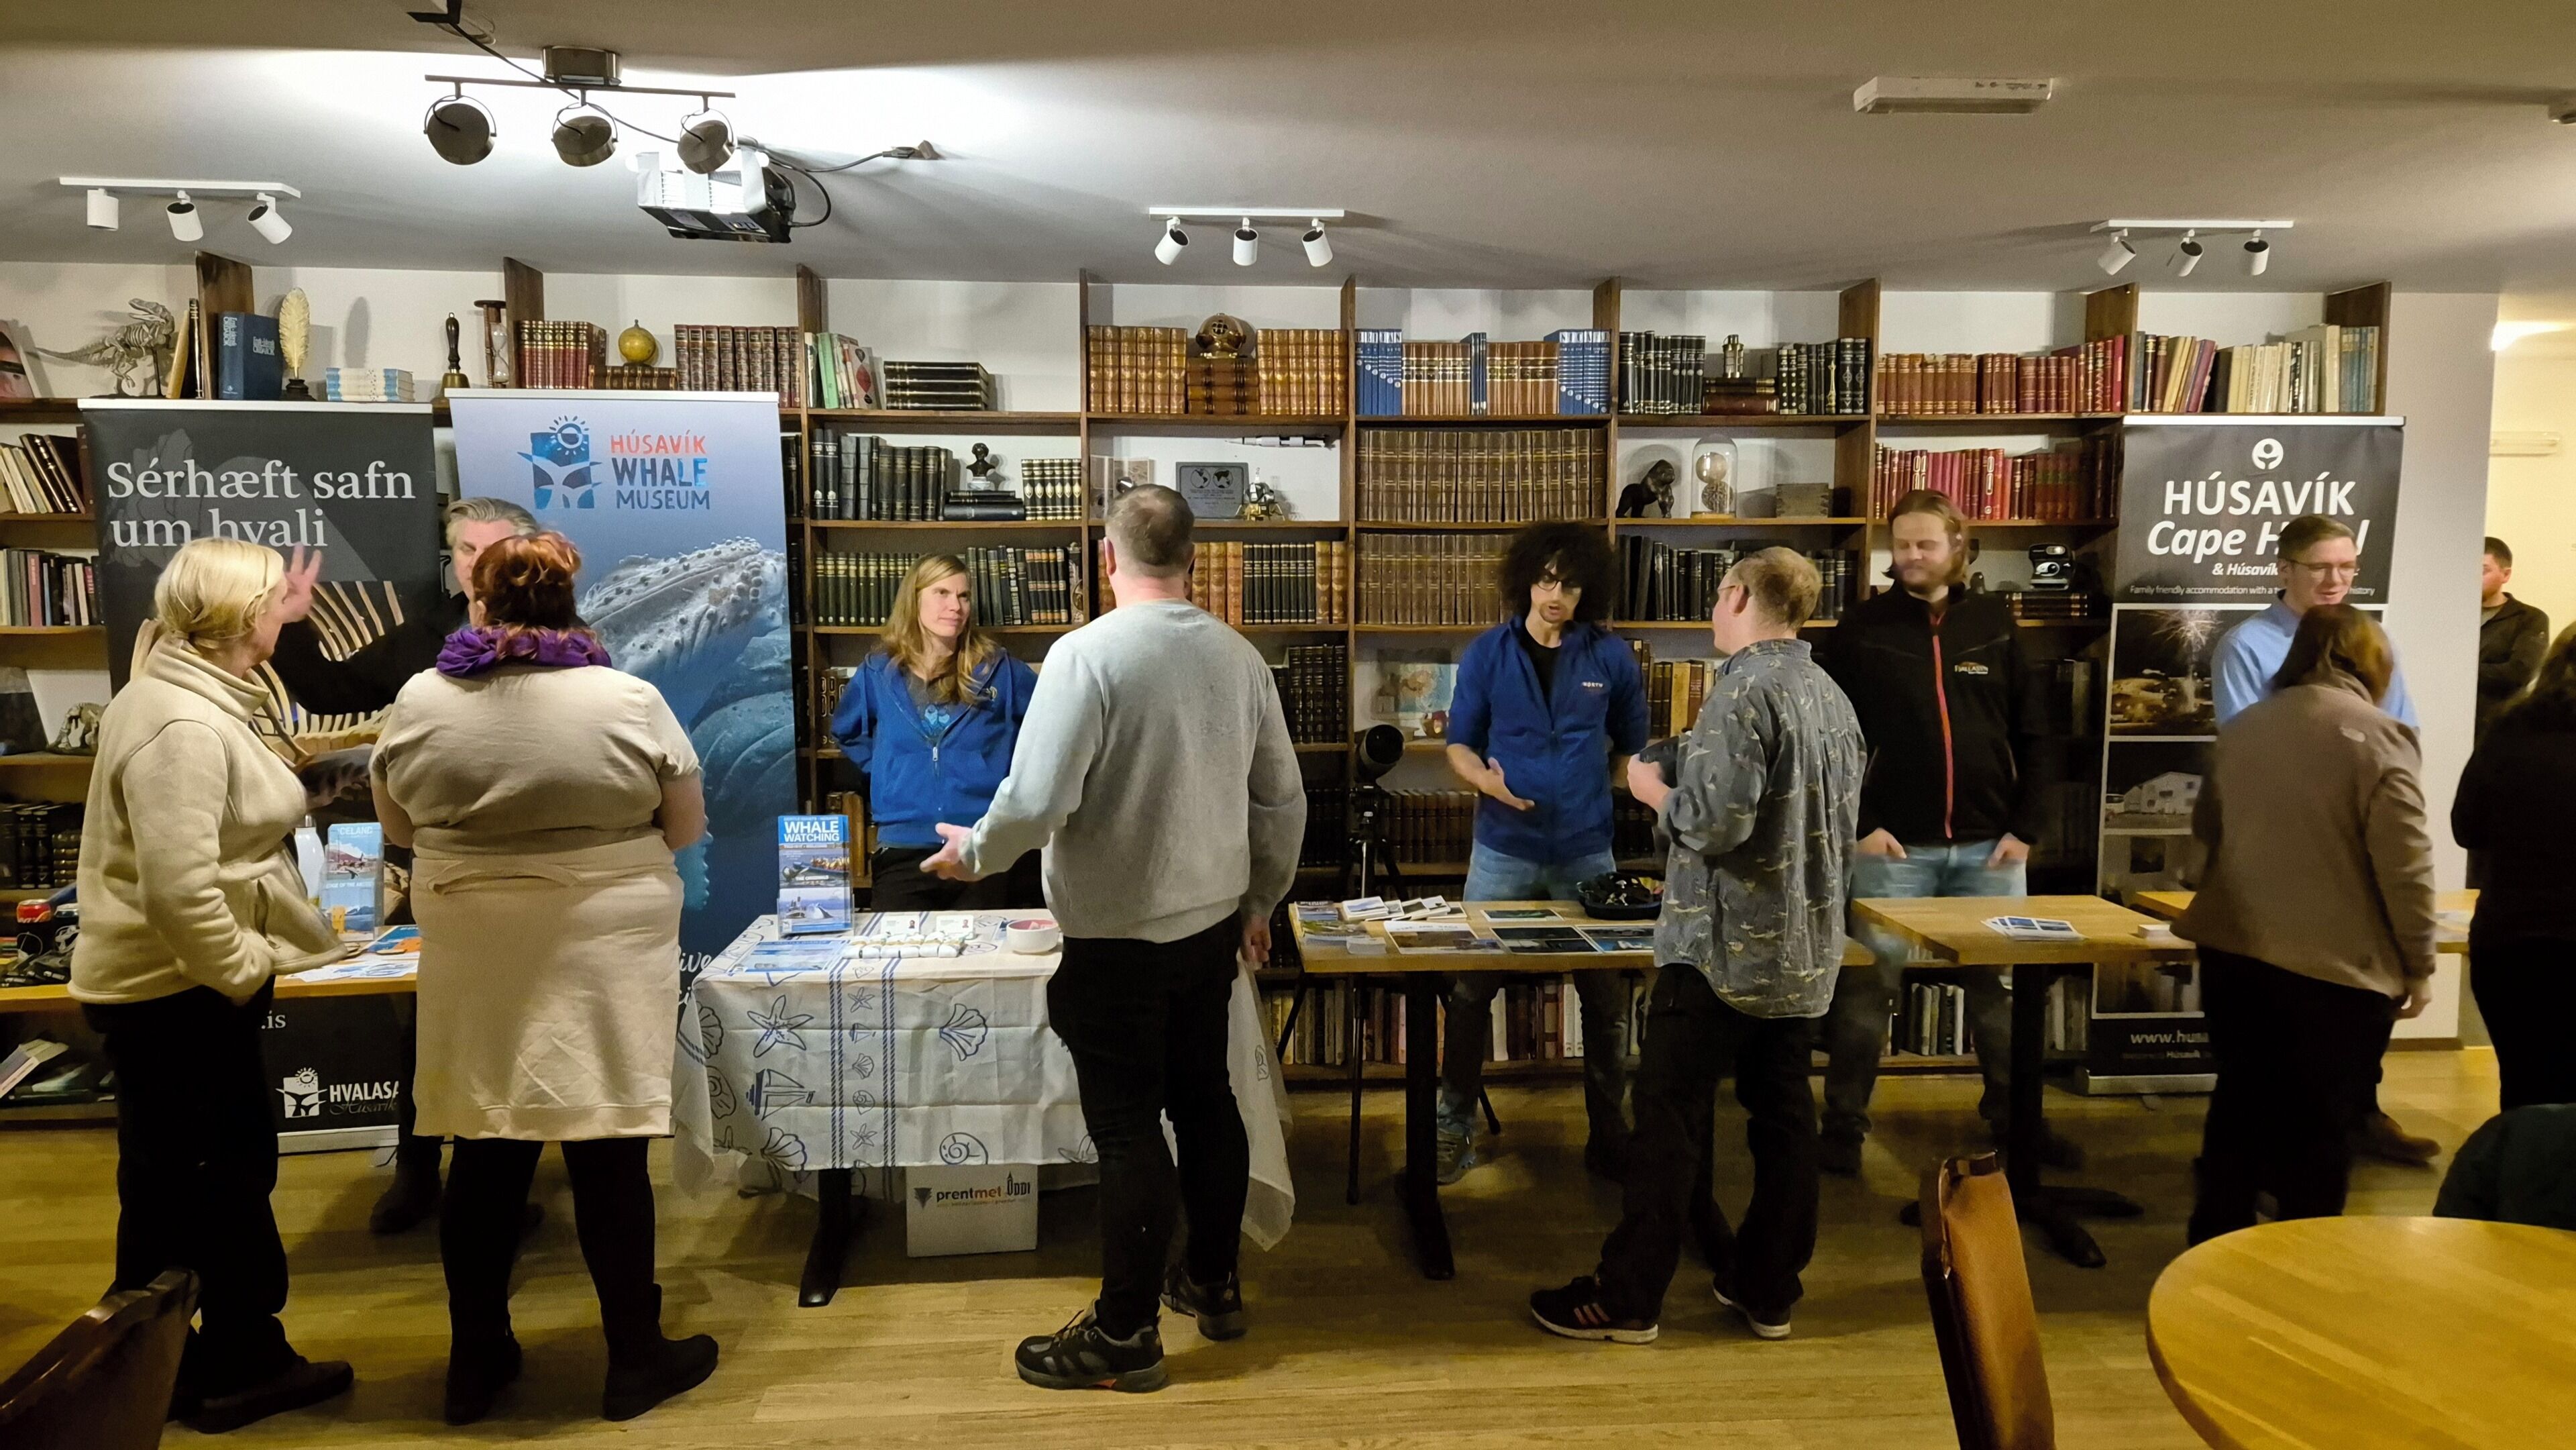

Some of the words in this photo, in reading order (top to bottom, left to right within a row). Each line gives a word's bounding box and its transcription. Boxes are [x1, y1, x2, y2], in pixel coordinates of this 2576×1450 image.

[610, 429, 706, 454] HÚSAVÍK
[107, 458, 301, 499] Sérhæft
[313, 460, 416, 499] safn
[611, 458, 708, 486] WHALE
[616, 490, 710, 510] MUSEUM
[2164, 471, 2356, 515] HÚSAVÍK
[110, 519, 192, 547] um
[209, 508, 327, 547] hvali
[2147, 520, 2247, 564] Cape
[2212, 563, 2224, 575] &
[2226, 562, 2278, 576] Húsavík
[2130, 585, 2155, 596] Family
[2155, 584, 2184, 596] friendly
[2186, 585, 2248, 594] accommodation
[2249, 585, 2266, 594] with
[784, 821, 839, 833] WHALE
[784, 833, 840, 842] WATCHING
[261, 1010, 286, 1029] .is
[936, 1186, 1002, 1202] prentmet
